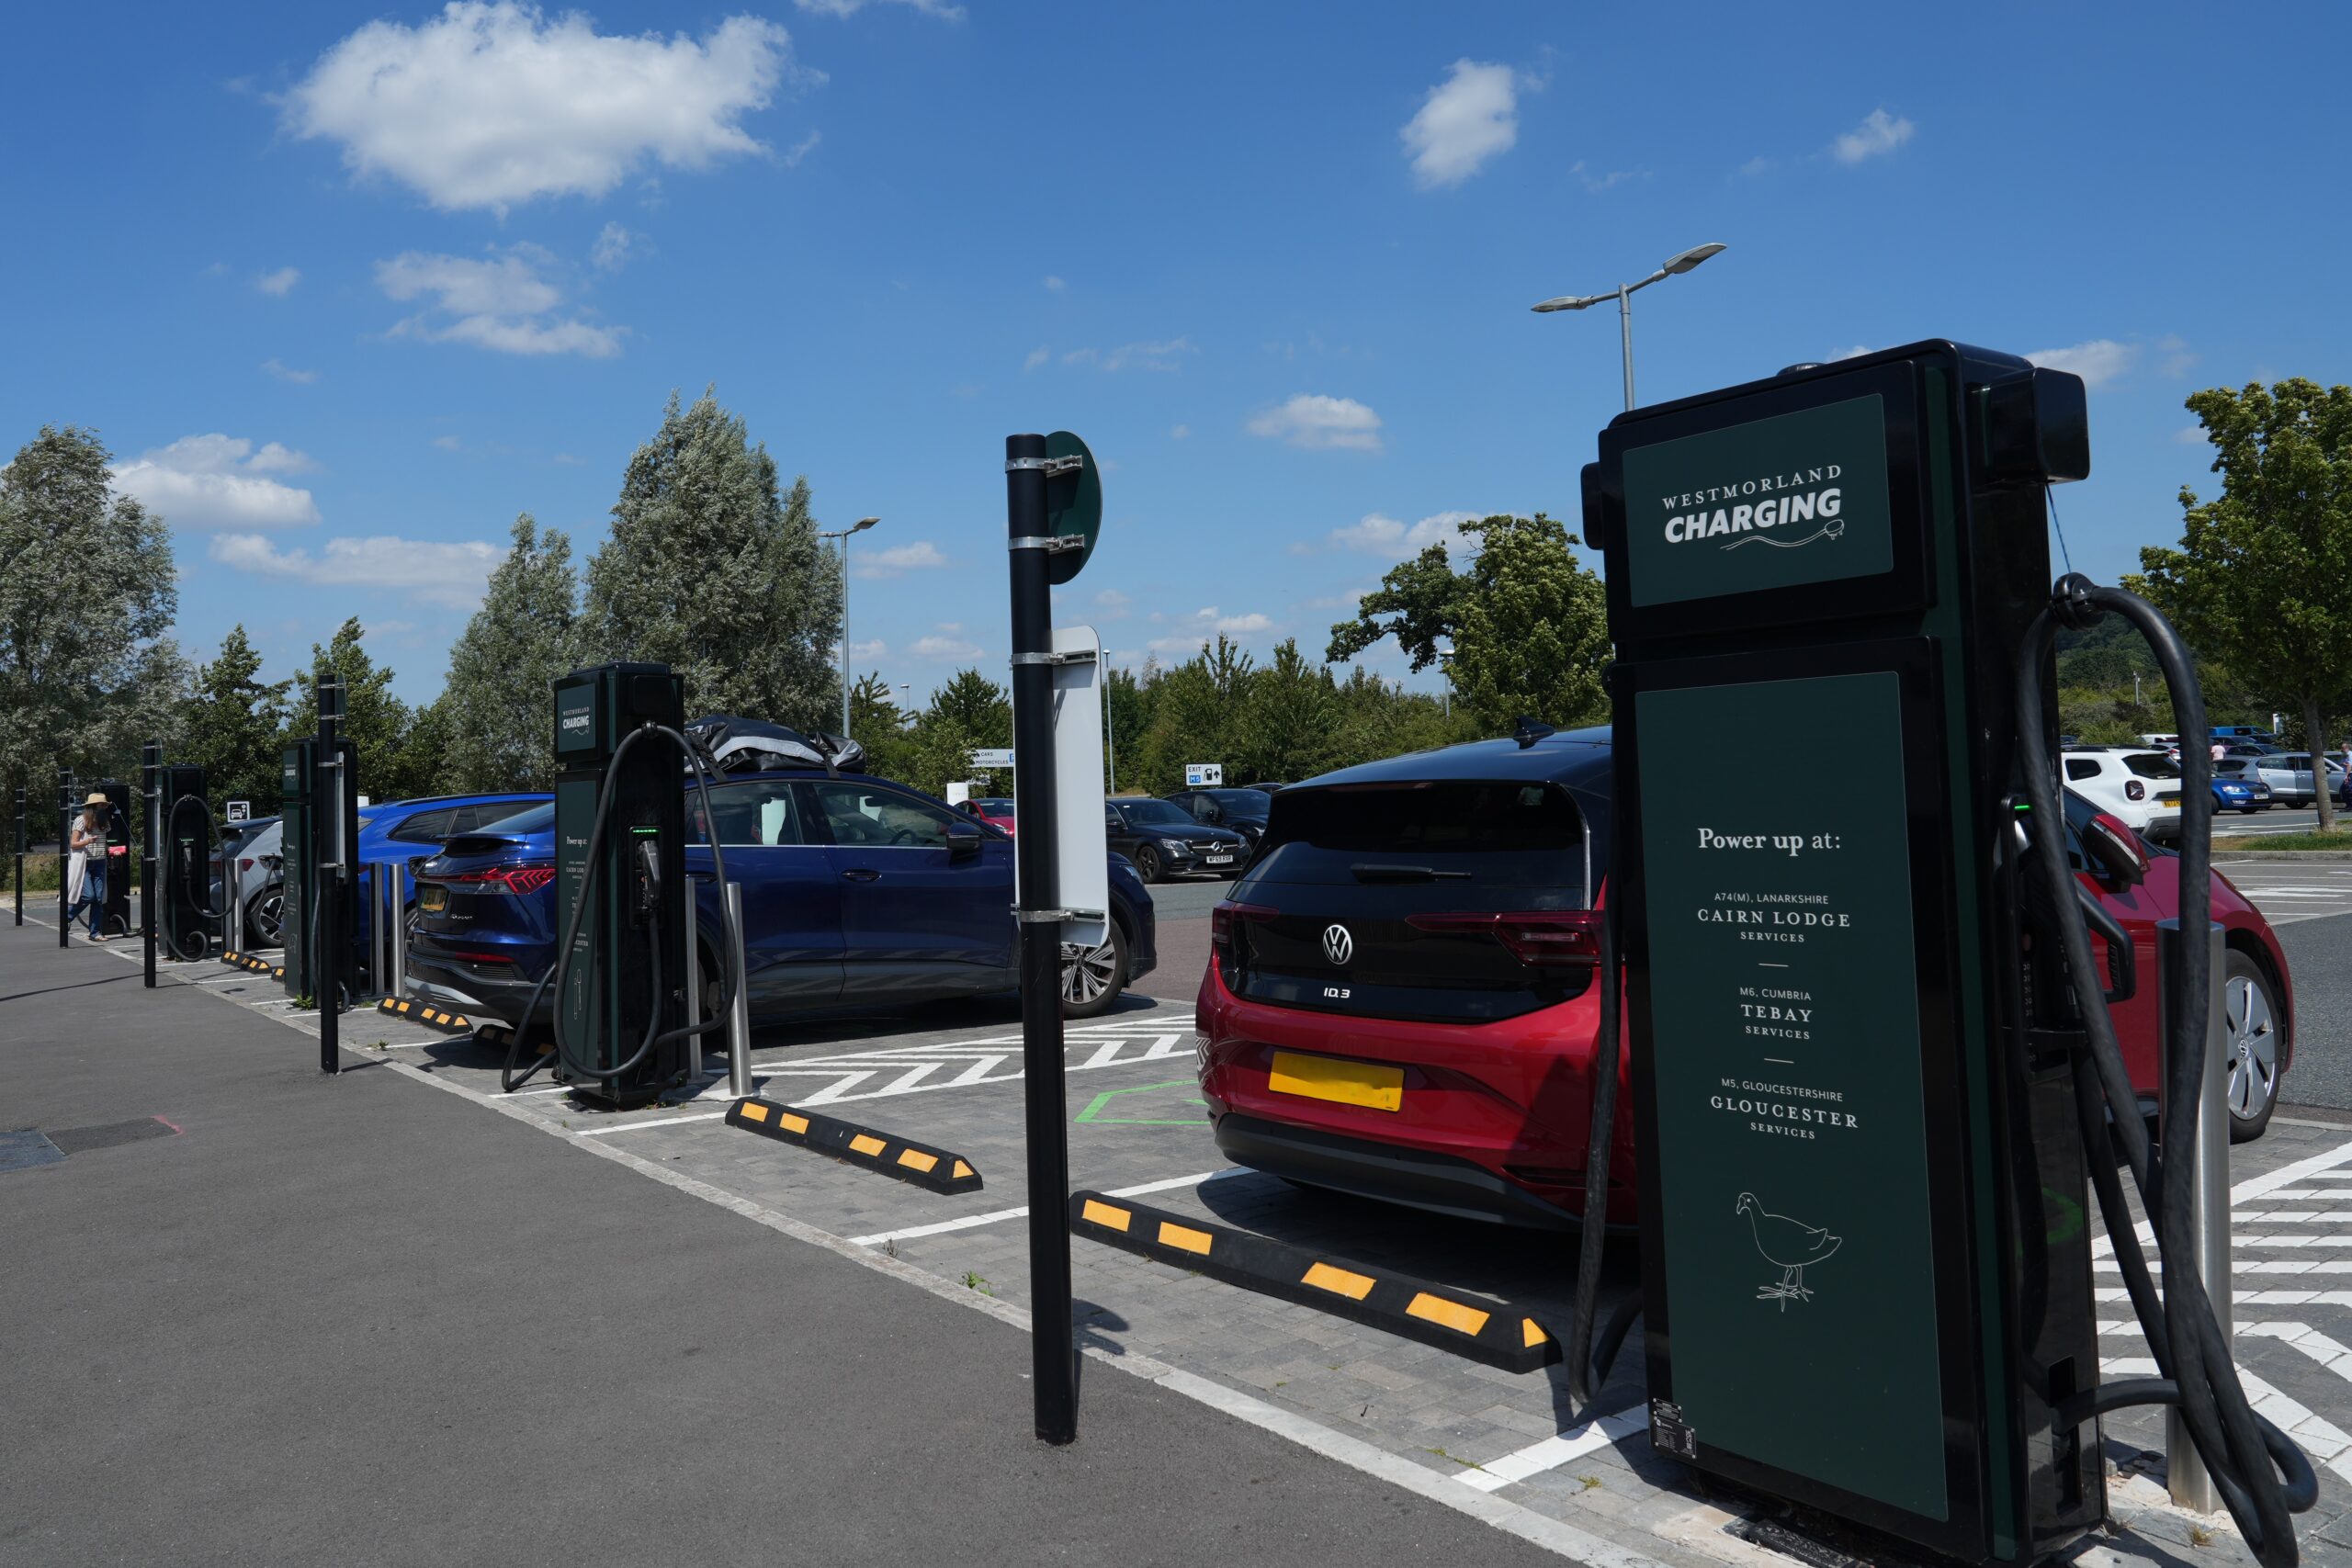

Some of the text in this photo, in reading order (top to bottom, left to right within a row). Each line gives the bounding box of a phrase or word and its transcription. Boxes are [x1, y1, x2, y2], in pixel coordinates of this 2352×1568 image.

[1662, 465, 1841, 510] WESTMORLAND
[1665, 488, 1841, 544] CHARGING
[562, 715, 590, 729] CHARGING
[1698, 828, 1841, 857] Power up at:
[1714, 892, 1829, 905] A74(M), LANARKSHIRE
[1698, 909, 1850, 927] CAIRN LODGE
[1740, 931, 1805, 942] SERVICES
[1740, 987, 1812, 1001] M6, CUMBRIA
[1741, 1004, 1813, 1022] TEBAY
[1746, 1025, 1811, 1040] SERVICES
[1721, 1077, 1843, 1102] M5, GLOUCESTERSHIRE
[1711, 1096, 1859, 1129] GLOUCESTER
[1750, 1122, 1815, 1140] SERVICES
